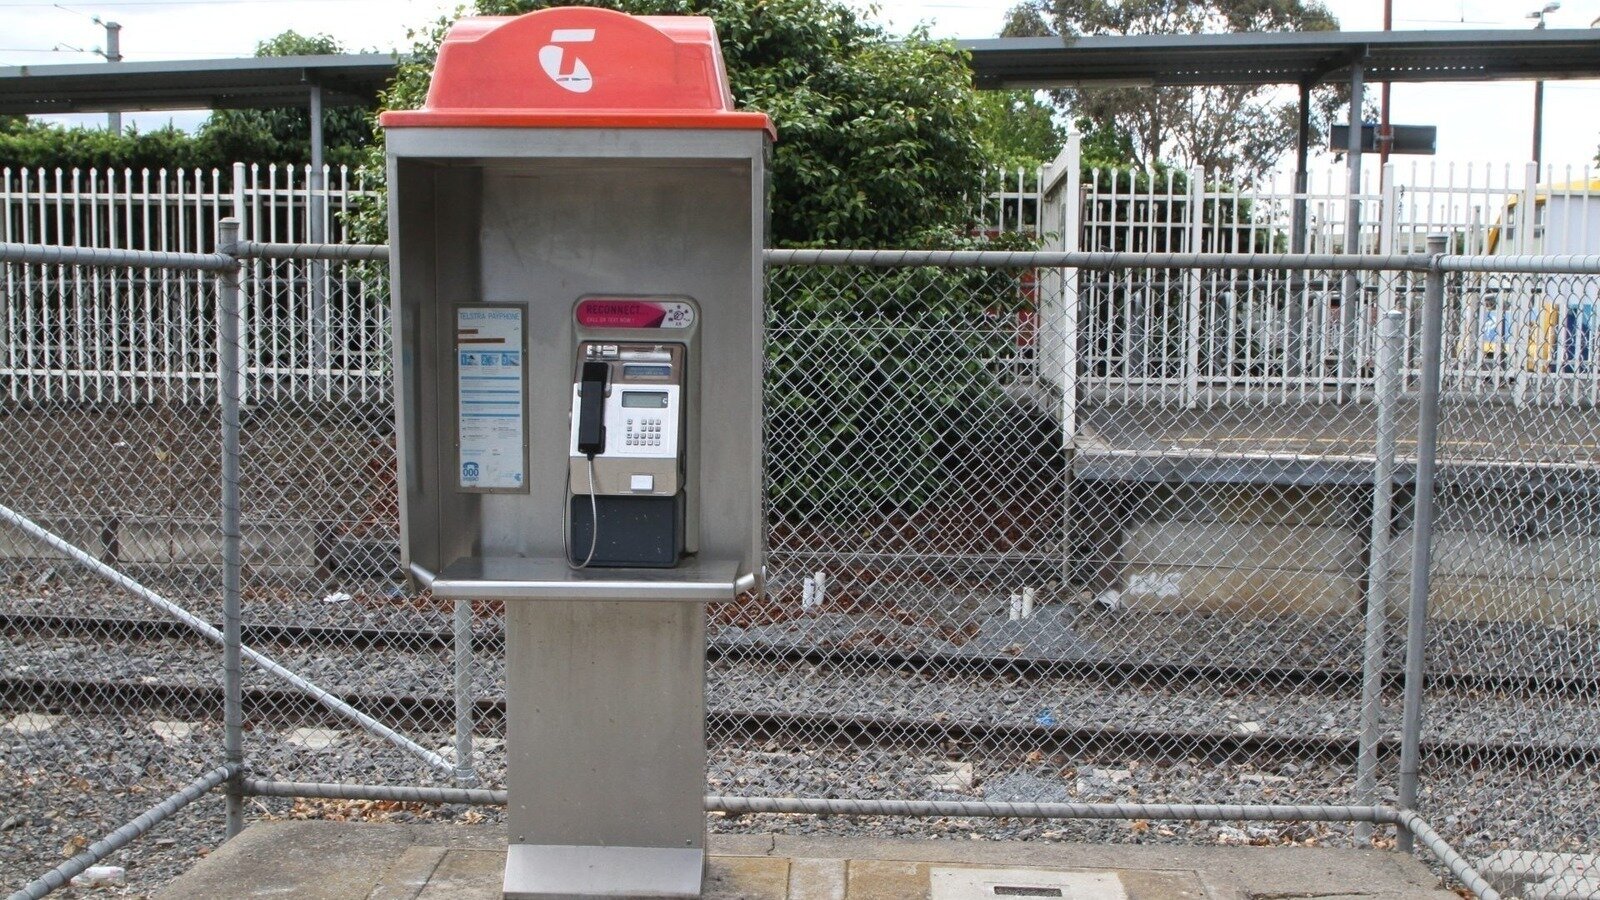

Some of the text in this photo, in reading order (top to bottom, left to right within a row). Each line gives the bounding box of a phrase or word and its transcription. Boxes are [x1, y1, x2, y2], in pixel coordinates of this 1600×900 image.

[460, 312, 520, 321] TELSTRA PAYPHONE
[463, 468, 479, 477] 000
